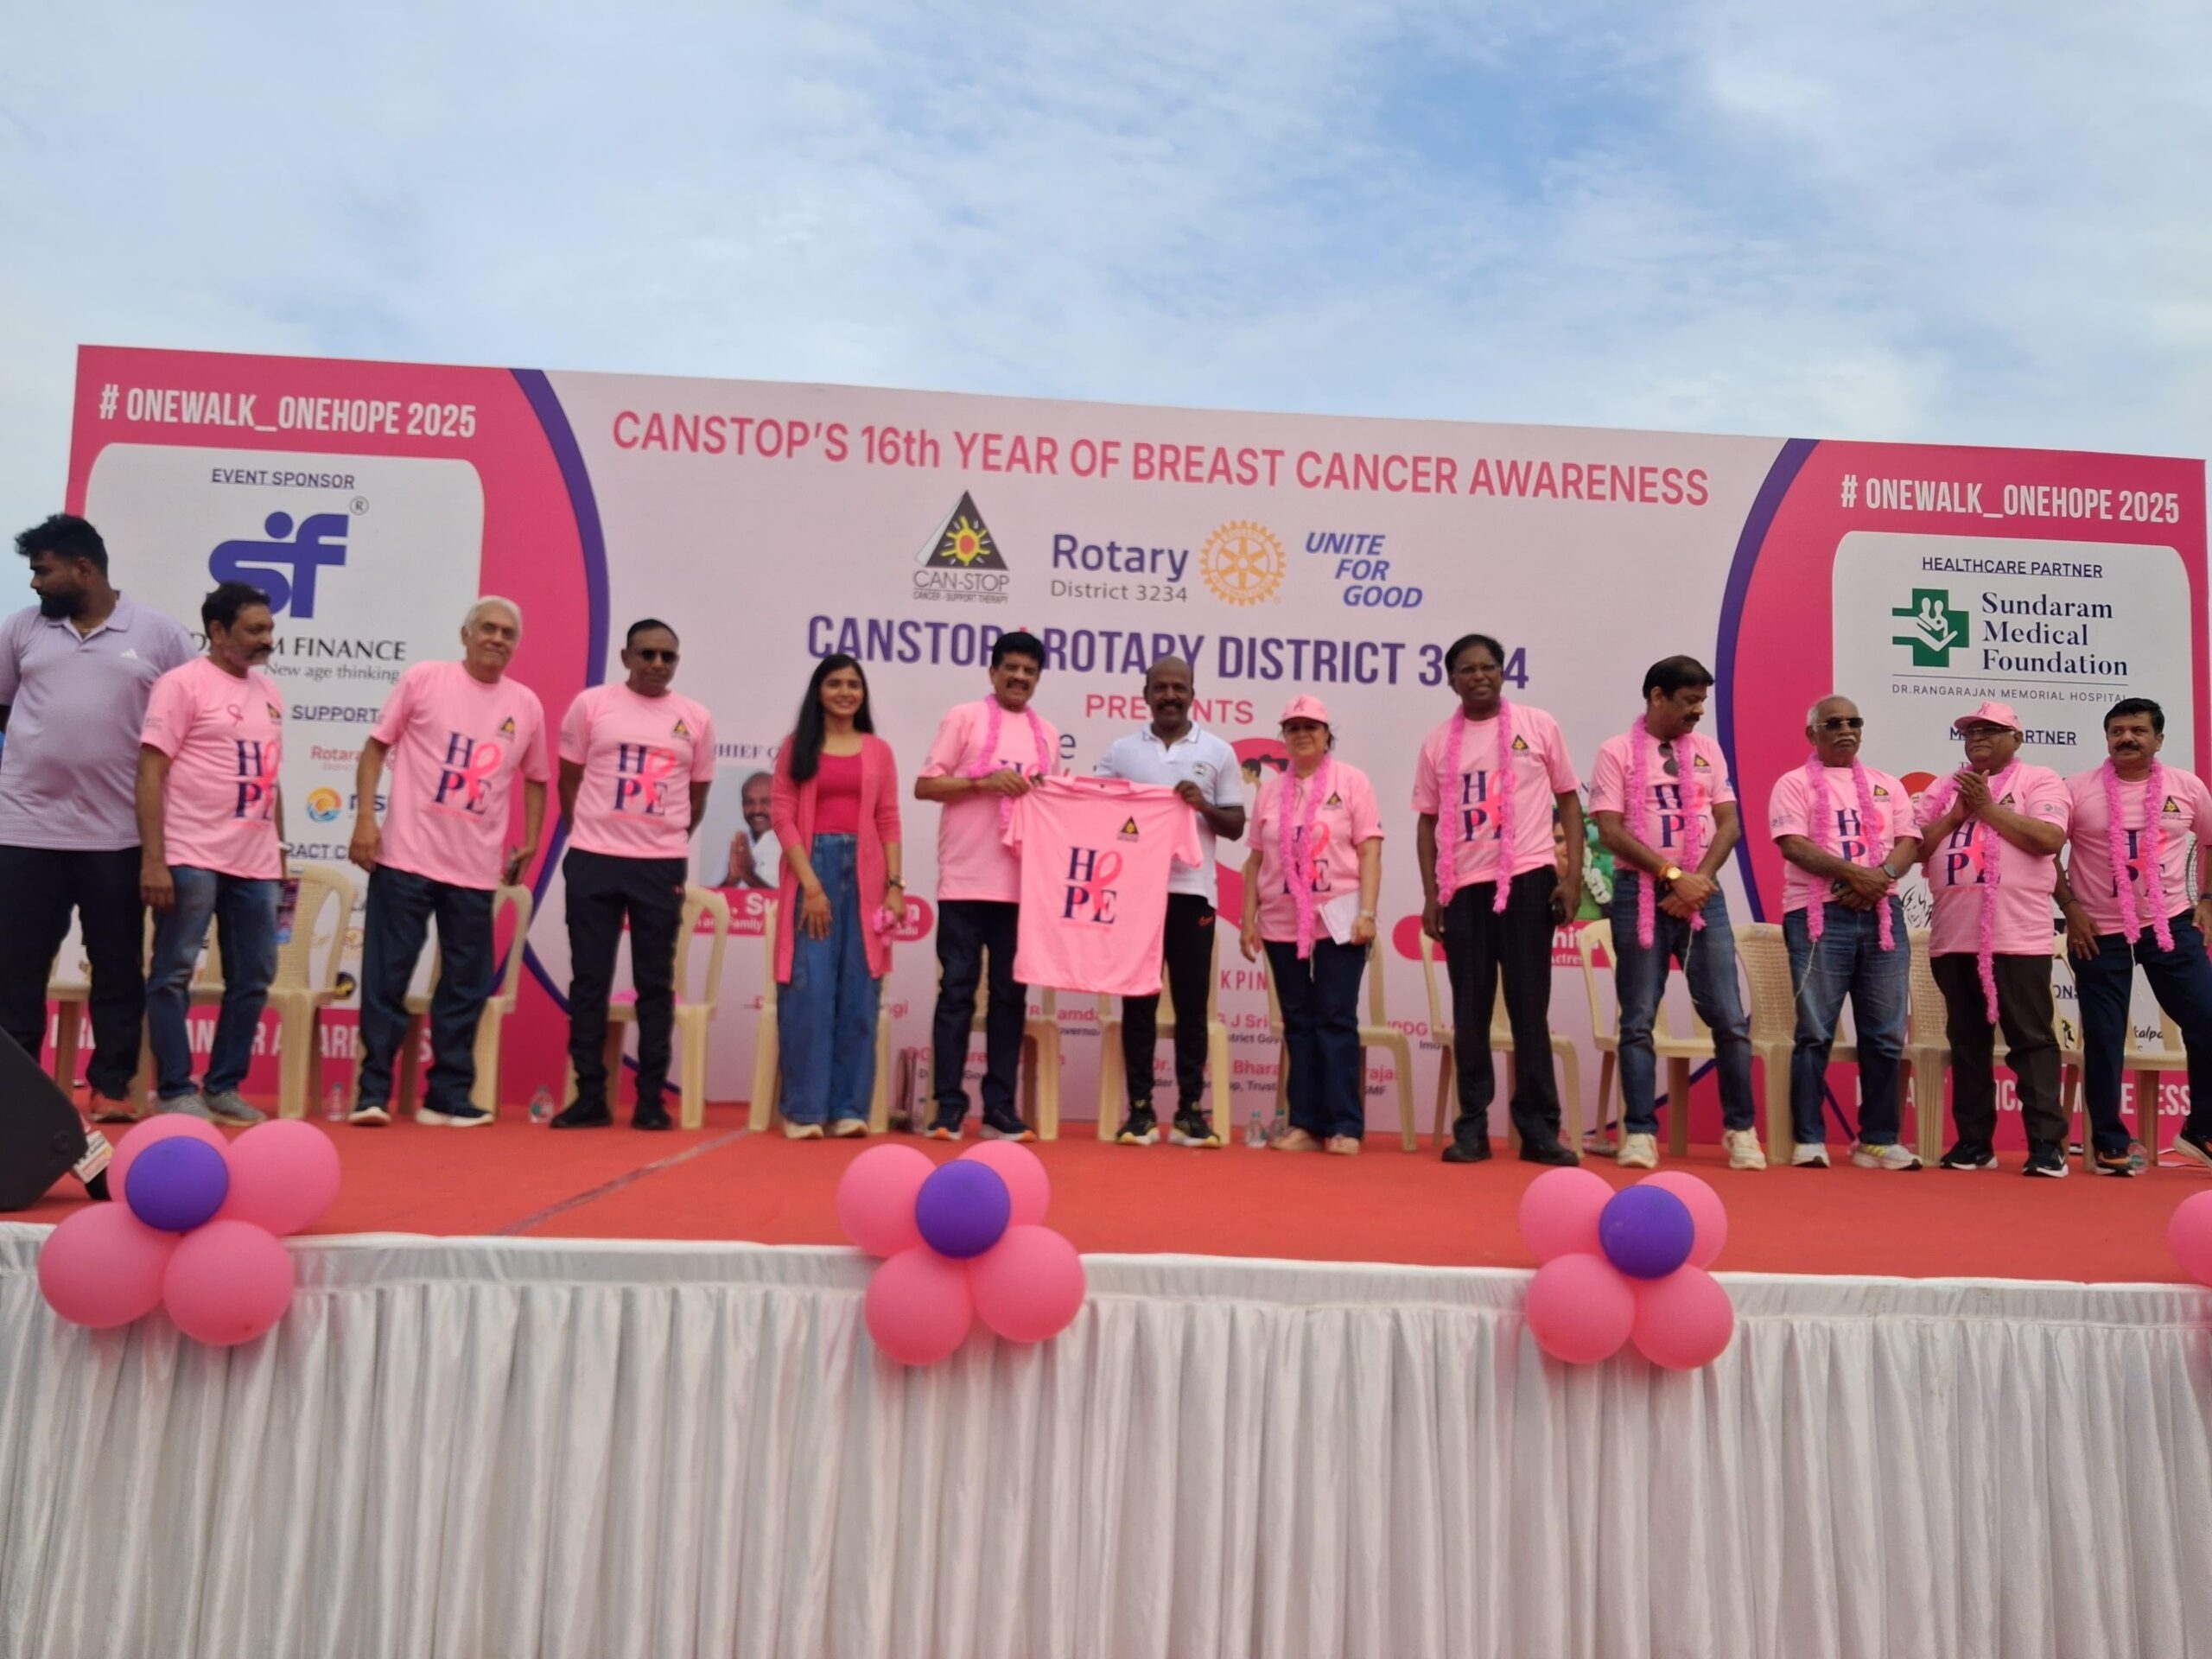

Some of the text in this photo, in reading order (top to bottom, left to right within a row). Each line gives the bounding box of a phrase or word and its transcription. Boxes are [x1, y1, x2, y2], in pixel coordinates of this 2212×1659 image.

[99, 384, 476, 438] # ONEWALK_ONEHOPE 2025
[860, 425, 941, 468] 16th
[954, 431, 1059, 475] YEAR
[1071, 439, 1122, 480] OF
[1133, 442, 1285, 486] BREAST
[1296, 450, 1458, 494] CANCER
[1469, 459, 1709, 506] AWARENESS
[211, 468, 355, 489] EVENT SPONSOR
[1841, 474, 2180, 524] # ONEWALK_ONEHOPE 2025
[1305, 532, 1385, 556] UNITE
[1052, 534, 1188, 582] Rotary
[1922, 556, 2103, 578] HEALTHCARE PARTNER
[913, 570, 1009, 591] CAN-STOP
[1335, 559, 1389, 581] FOR
[1051, 579, 1187, 602] District 3234
[1343, 585, 1423, 608] GOOD
[1981, 591, 2113, 620] Sundaram
[1981, 620, 2088, 646] Medical
[294, 637, 407, 661] FINANCE
[265, 663, 400, 683] New age thinking
[1218, 636, 1407, 687] DISTRICT
[1419, 644, 1529, 689] 34
[1981, 649, 2129, 677] Foundation
[1892, 683, 1996, 698] DR.RANGARAJAN
[2000, 689, 2065, 702] MEMORIAL
[292, 705, 379, 722] SUPPORT
[1086, 695, 1254, 724] PRENTS
[2022, 730, 2076, 746] RTNER
[714, 744, 764, 758] HIEF
